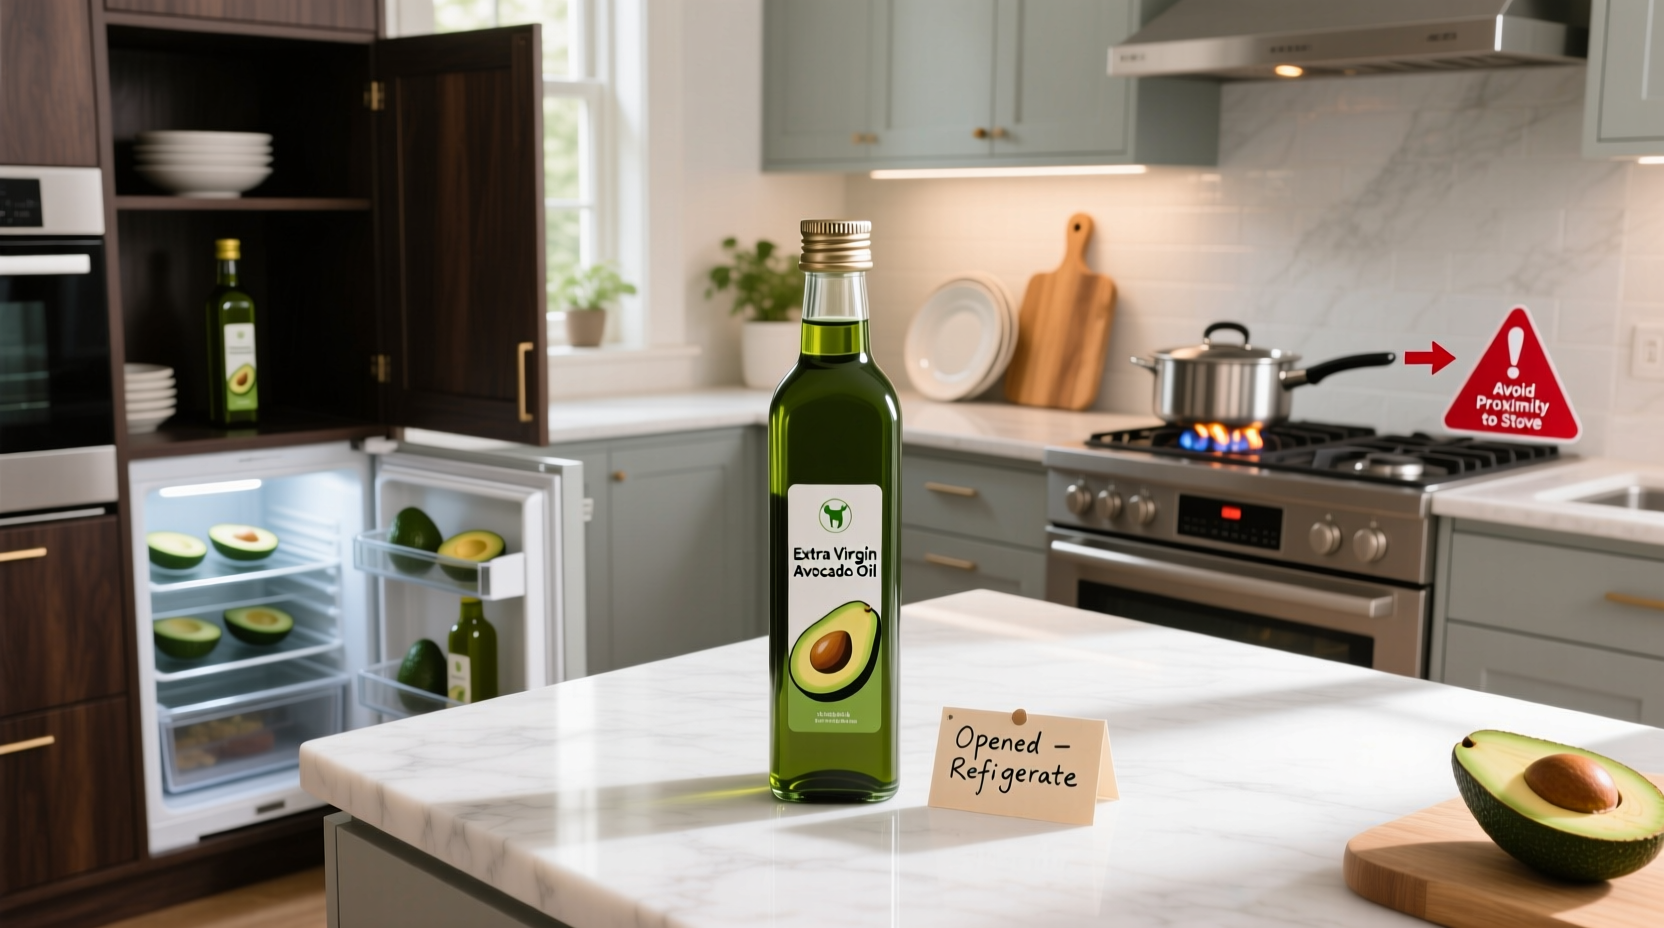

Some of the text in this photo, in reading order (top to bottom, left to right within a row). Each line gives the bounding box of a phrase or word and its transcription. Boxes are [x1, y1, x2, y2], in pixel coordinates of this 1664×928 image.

[1493, 382, 1536, 398] Avoid
[1481, 413, 1543, 430] to Stove
[793, 546, 877, 565] Extra Virgin
[793, 563, 877, 578] Avocado Oil
[955, 725, 1042, 761] Opened
[949, 756, 1078, 796] Refigerate
